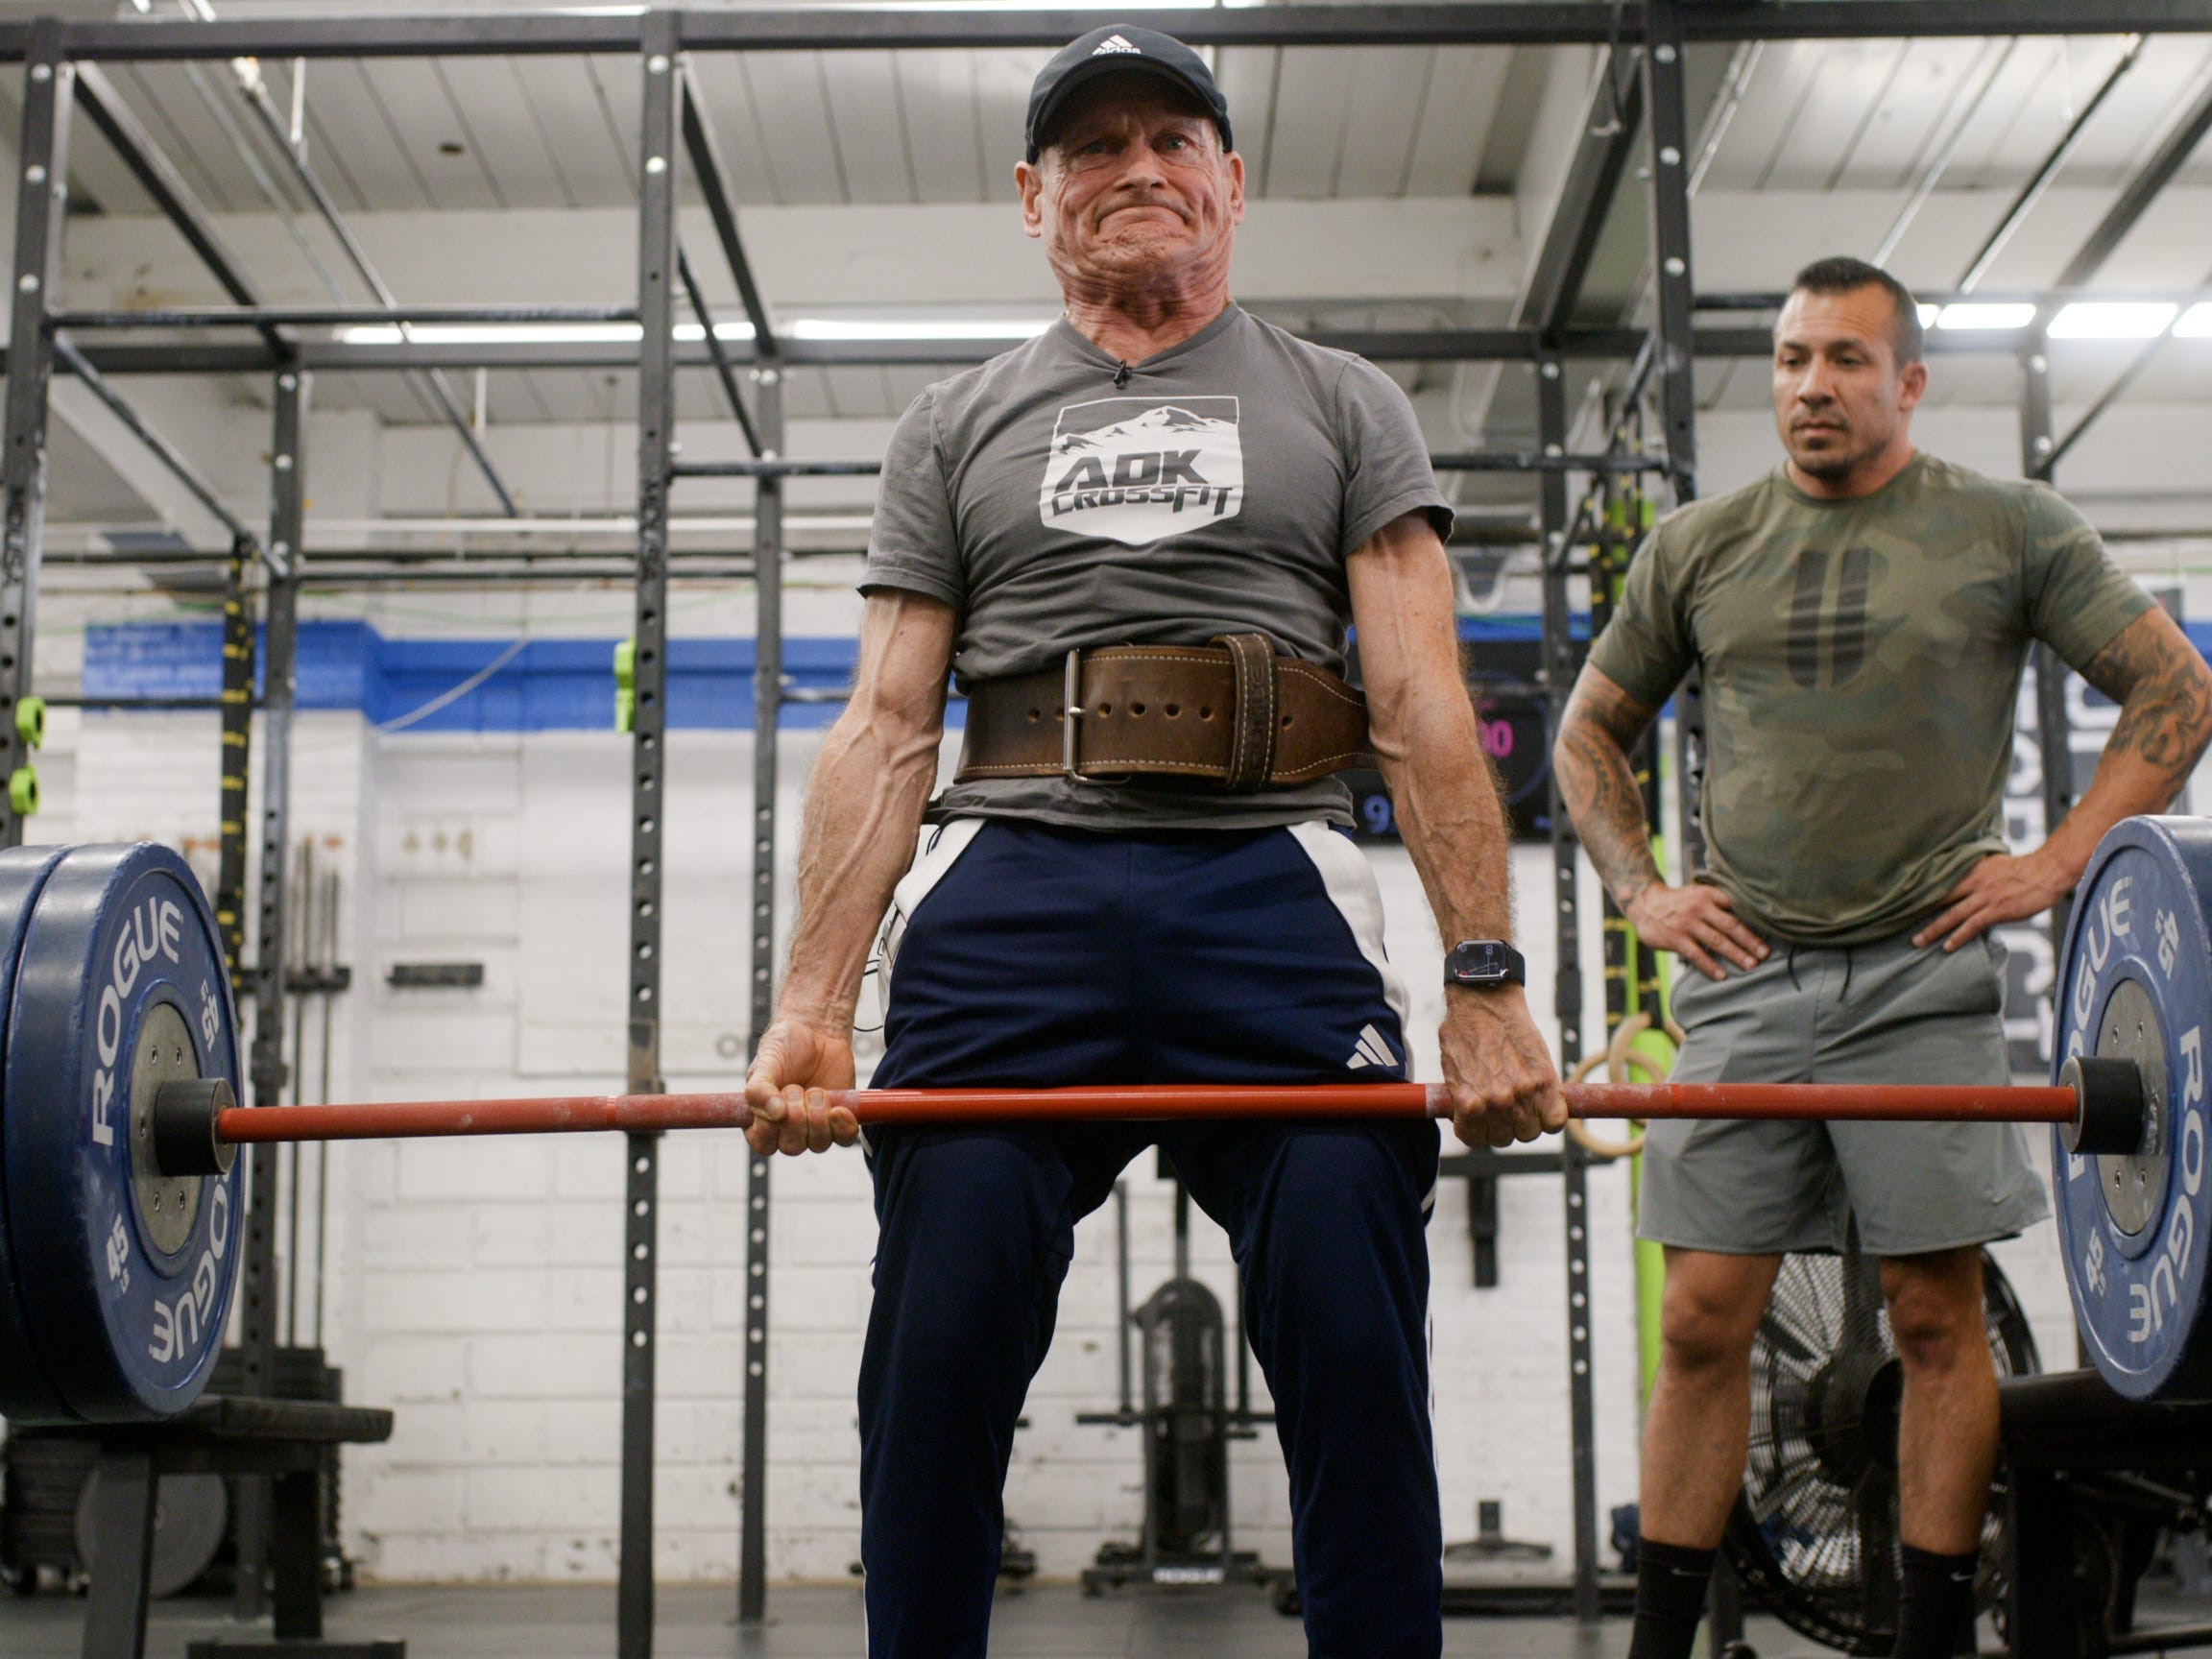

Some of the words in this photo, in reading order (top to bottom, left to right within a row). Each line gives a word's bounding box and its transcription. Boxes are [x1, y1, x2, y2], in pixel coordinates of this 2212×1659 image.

[1051, 486, 1233, 516] CROSSFIT
[1055, 449, 1209, 493] ADK
[2158, 909, 2179, 981] 45
[92, 897, 181, 1146] ROGUE
[202, 994, 219, 1052] 45
[2130, 1025, 2203, 1342] ROGUE
[107, 1213, 129, 1282] 45
[151, 1172, 229, 1363] OGUE
[2085, 1226, 2104, 1292] 45
